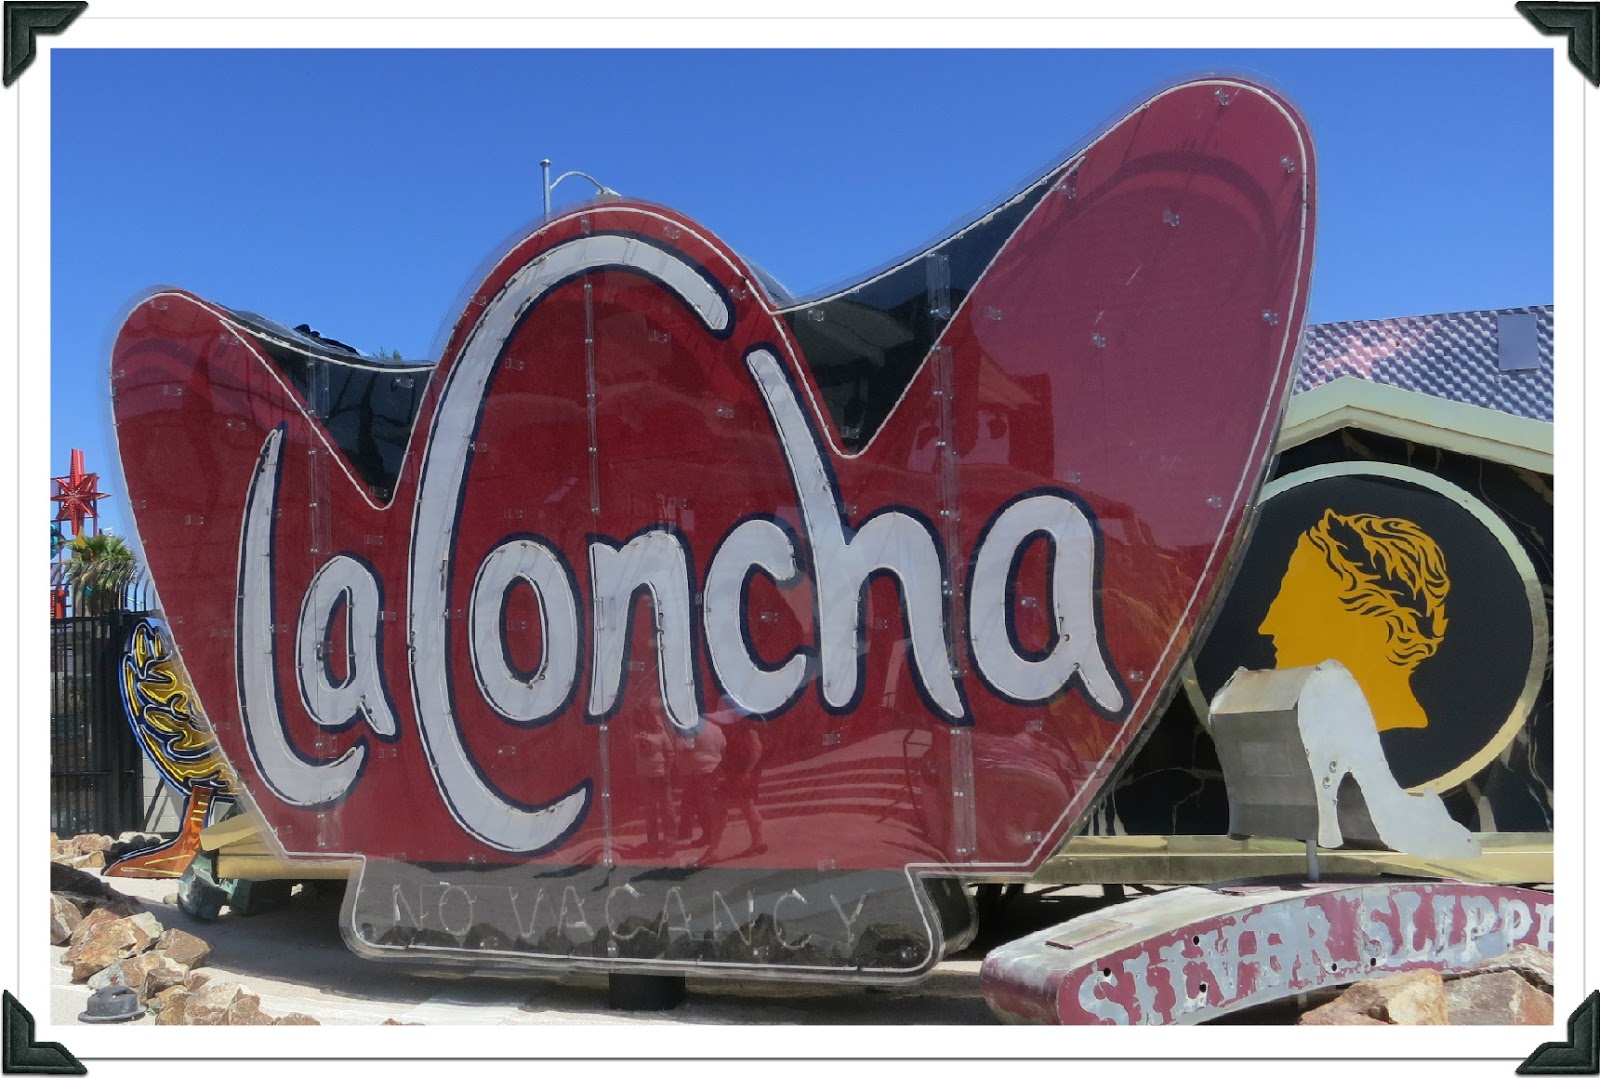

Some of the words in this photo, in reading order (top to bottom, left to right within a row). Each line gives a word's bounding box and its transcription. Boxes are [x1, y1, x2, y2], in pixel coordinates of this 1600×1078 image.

[407, 231, 1132, 855] Concha
[392, 883, 476, 937] NO
[508, 885, 871, 949] VACANCY
